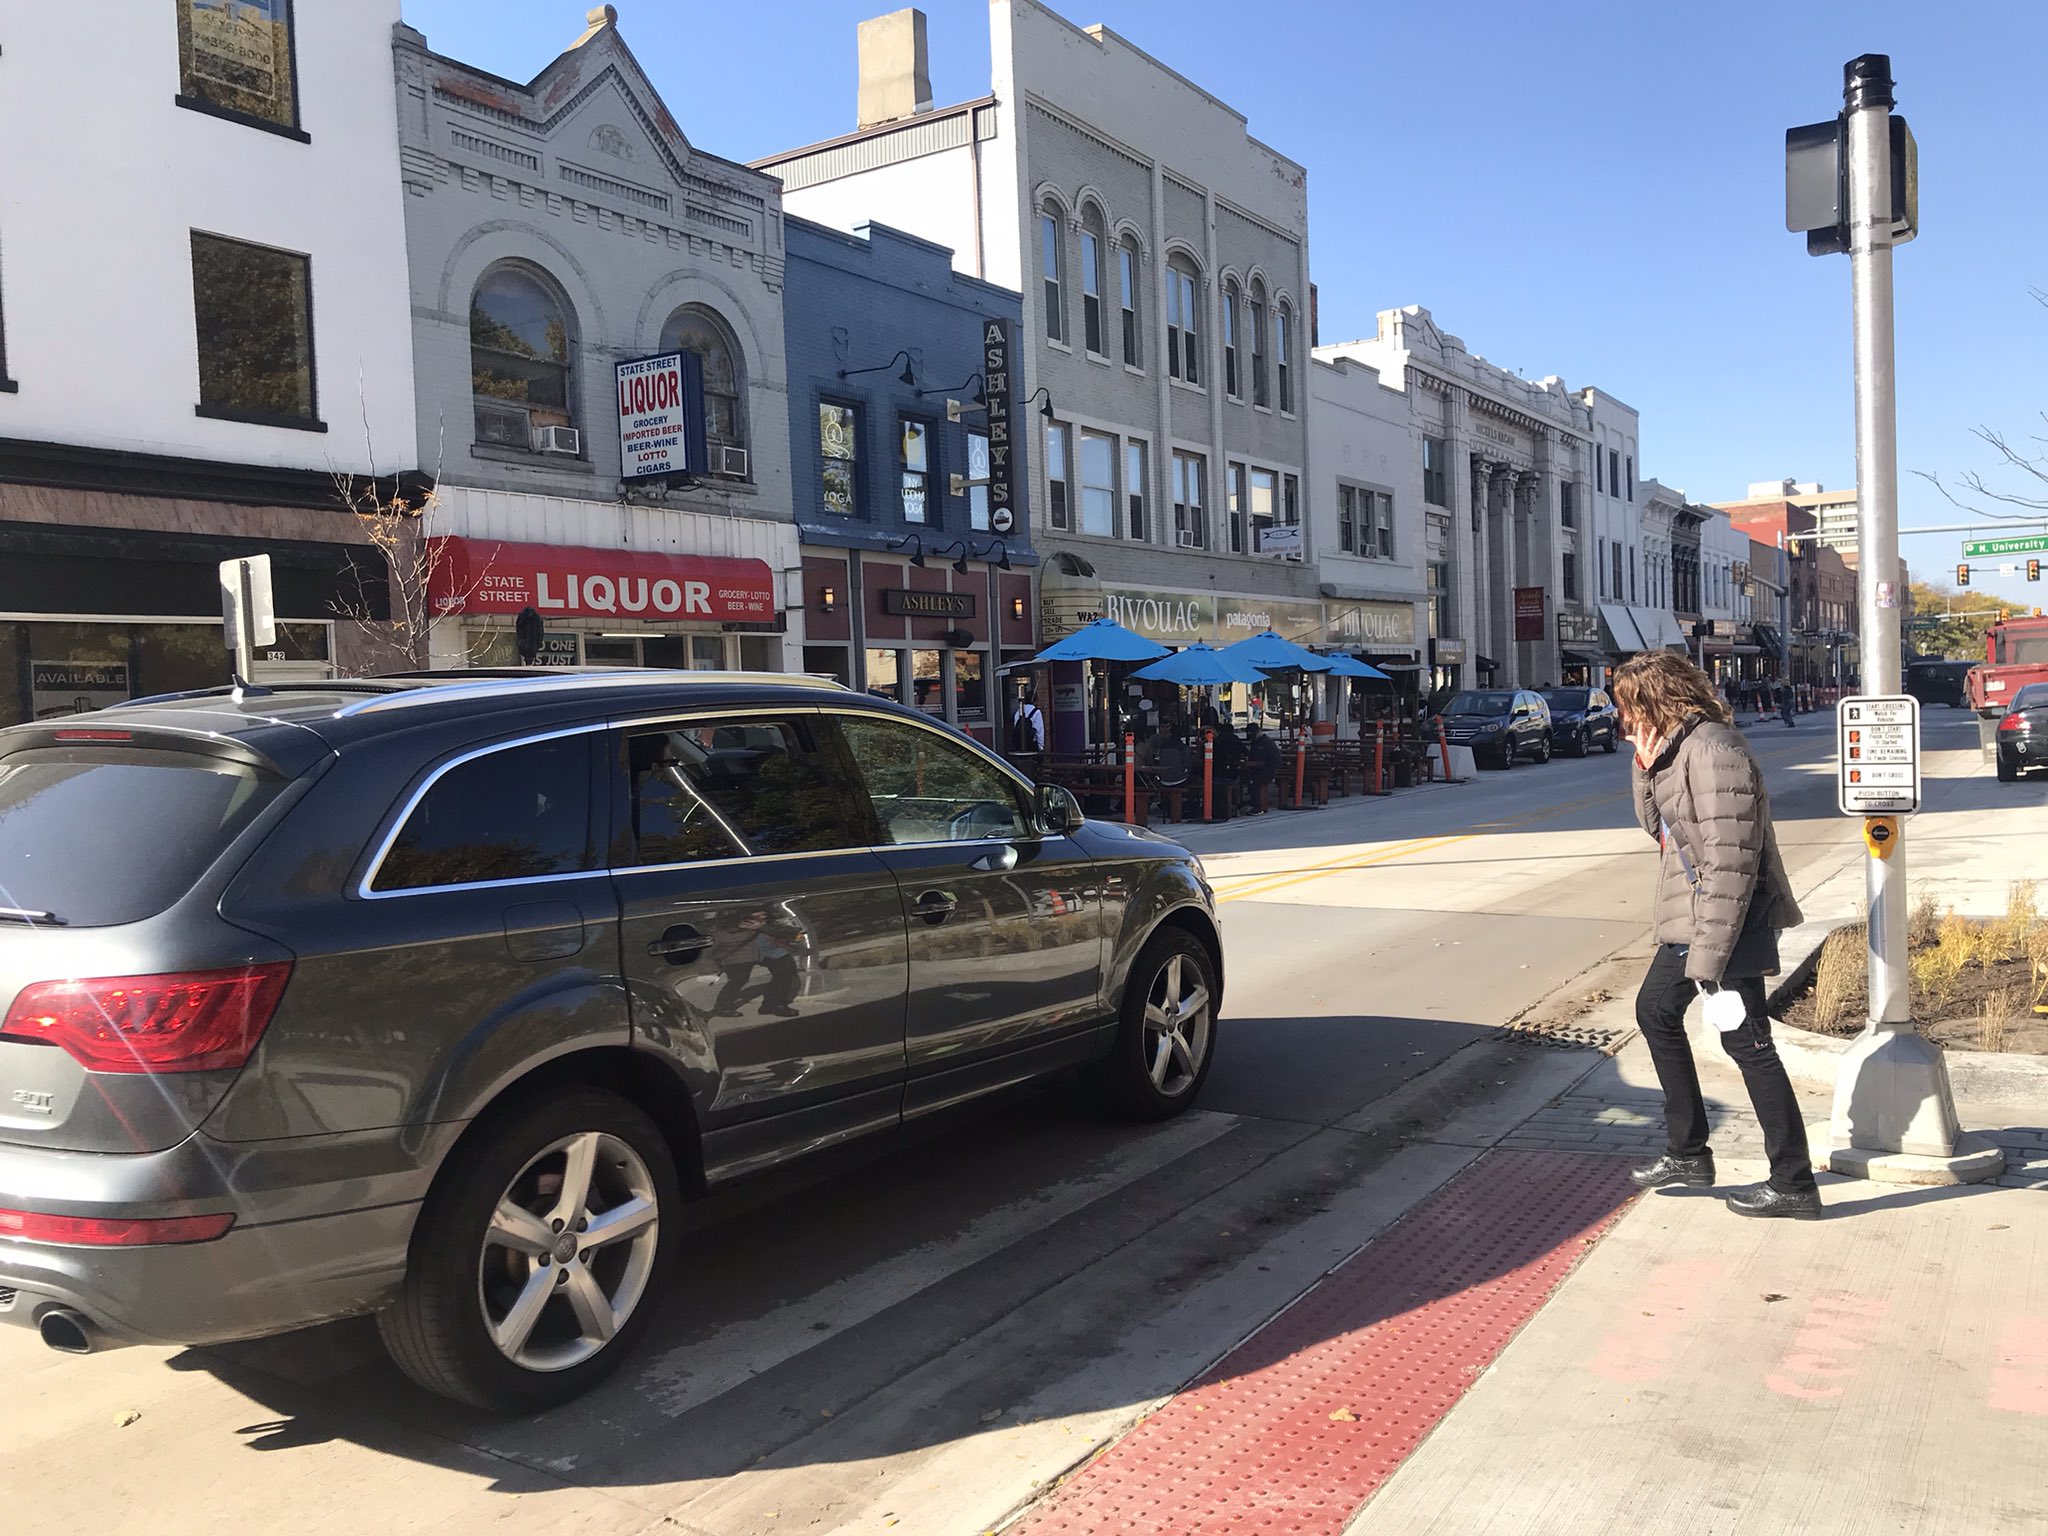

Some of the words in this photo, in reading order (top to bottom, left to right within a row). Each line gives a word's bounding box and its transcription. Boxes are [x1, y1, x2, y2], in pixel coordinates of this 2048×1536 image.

[620, 363, 644, 377] STATE
[646, 357, 677, 372] STREET
[620, 371, 680, 416] LIQUOR
[985, 324, 1009, 502] ASHLEY'S
[633, 415, 669, 429] GROCERY
[623, 427, 660, 442] IMPORTED
[662, 424, 683, 435] BEER
[627, 437, 678, 453] BEER-WINE
[638, 450, 668, 462] LOTTO
[636, 461, 671, 474] CIGARS
[824, 490, 853, 504] YOGA
[901, 488, 926, 502] UDDHA
[1979, 544, 1989, 553] N.
[1992, 540, 2045, 552] University
[479, 590, 530, 603] STREET
[484, 576, 524, 589] STATE
[536, 572, 713, 615] LIQUOR
[902, 594, 965, 612] ASHLEY'S
[1106, 594, 1200, 633] BIVOUAC
[1226, 611, 1271, 631] patagonia
[1344, 610, 1400, 639] BIVOUAC
[550, 639, 575, 651] ONE
[269, 652, 284, 660] 342
[546, 654, 573, 665] JUST
[36, 672, 126, 684] AVAILABLE
